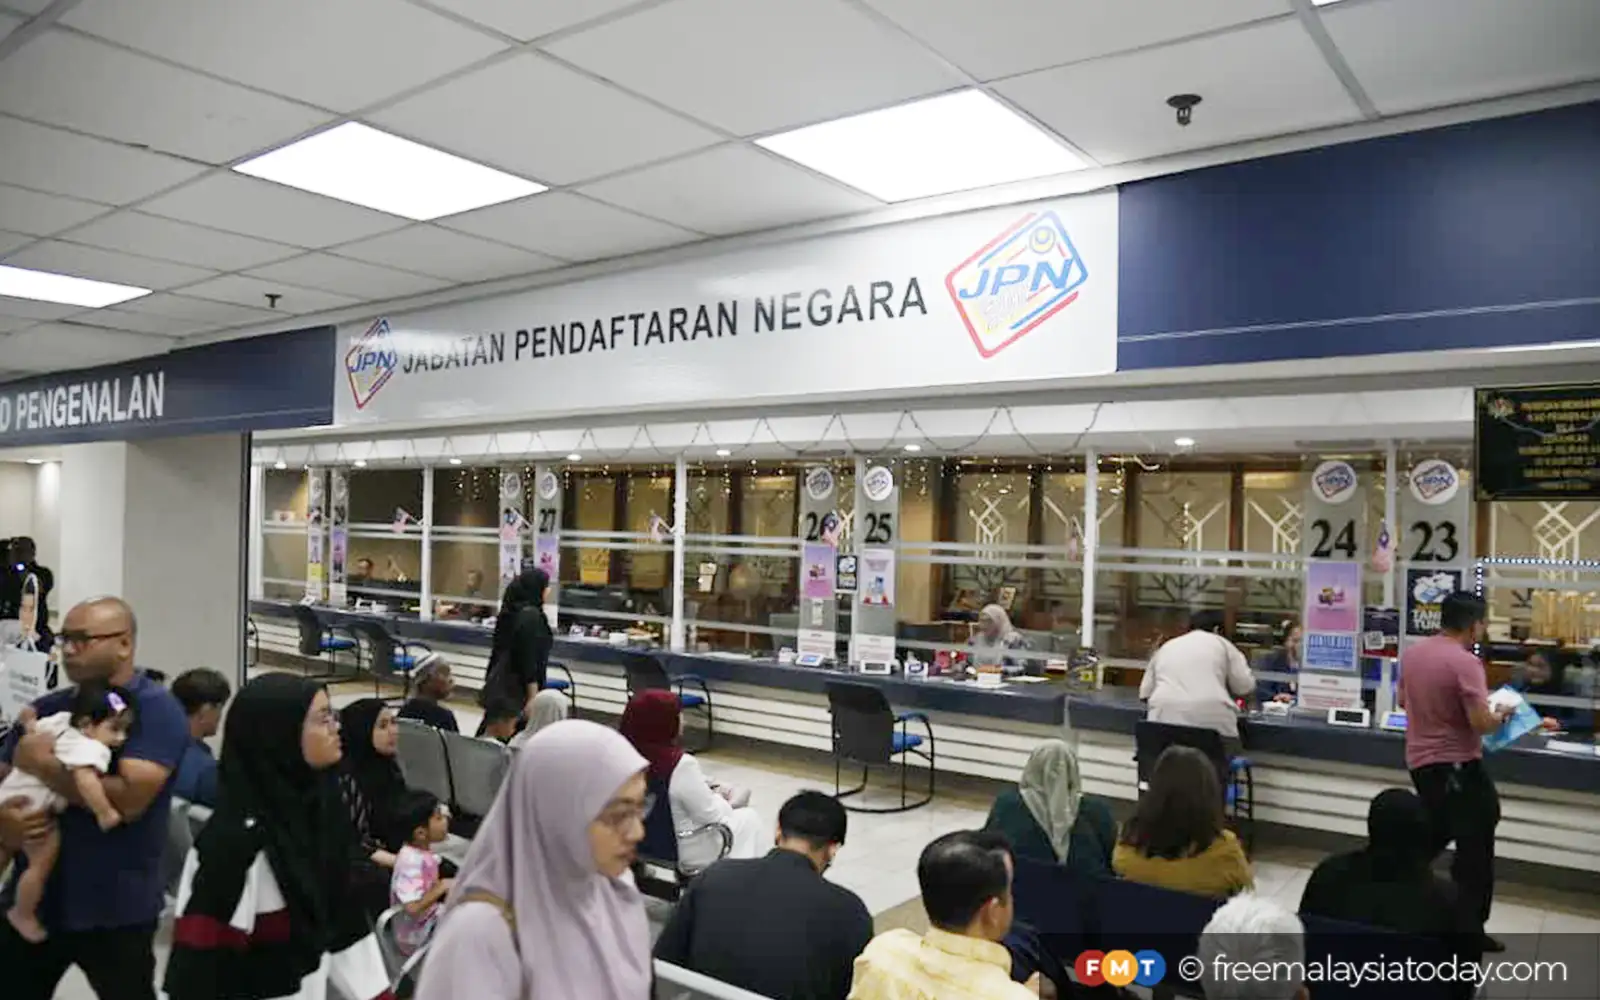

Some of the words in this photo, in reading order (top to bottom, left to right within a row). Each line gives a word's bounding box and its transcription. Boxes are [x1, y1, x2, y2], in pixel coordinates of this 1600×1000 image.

[957, 258, 1073, 298] JPN
[514, 300, 738, 361] PENDAFTARAN
[754, 277, 928, 333] NEGARA
[348, 351, 393, 373] JPN
[15, 371, 165, 431] PENGENALAN
[539, 508, 557, 533] 27
[864, 512, 892, 544] 25
[1311, 519, 1357, 558] 24
[1410, 520, 1459, 561] 23
